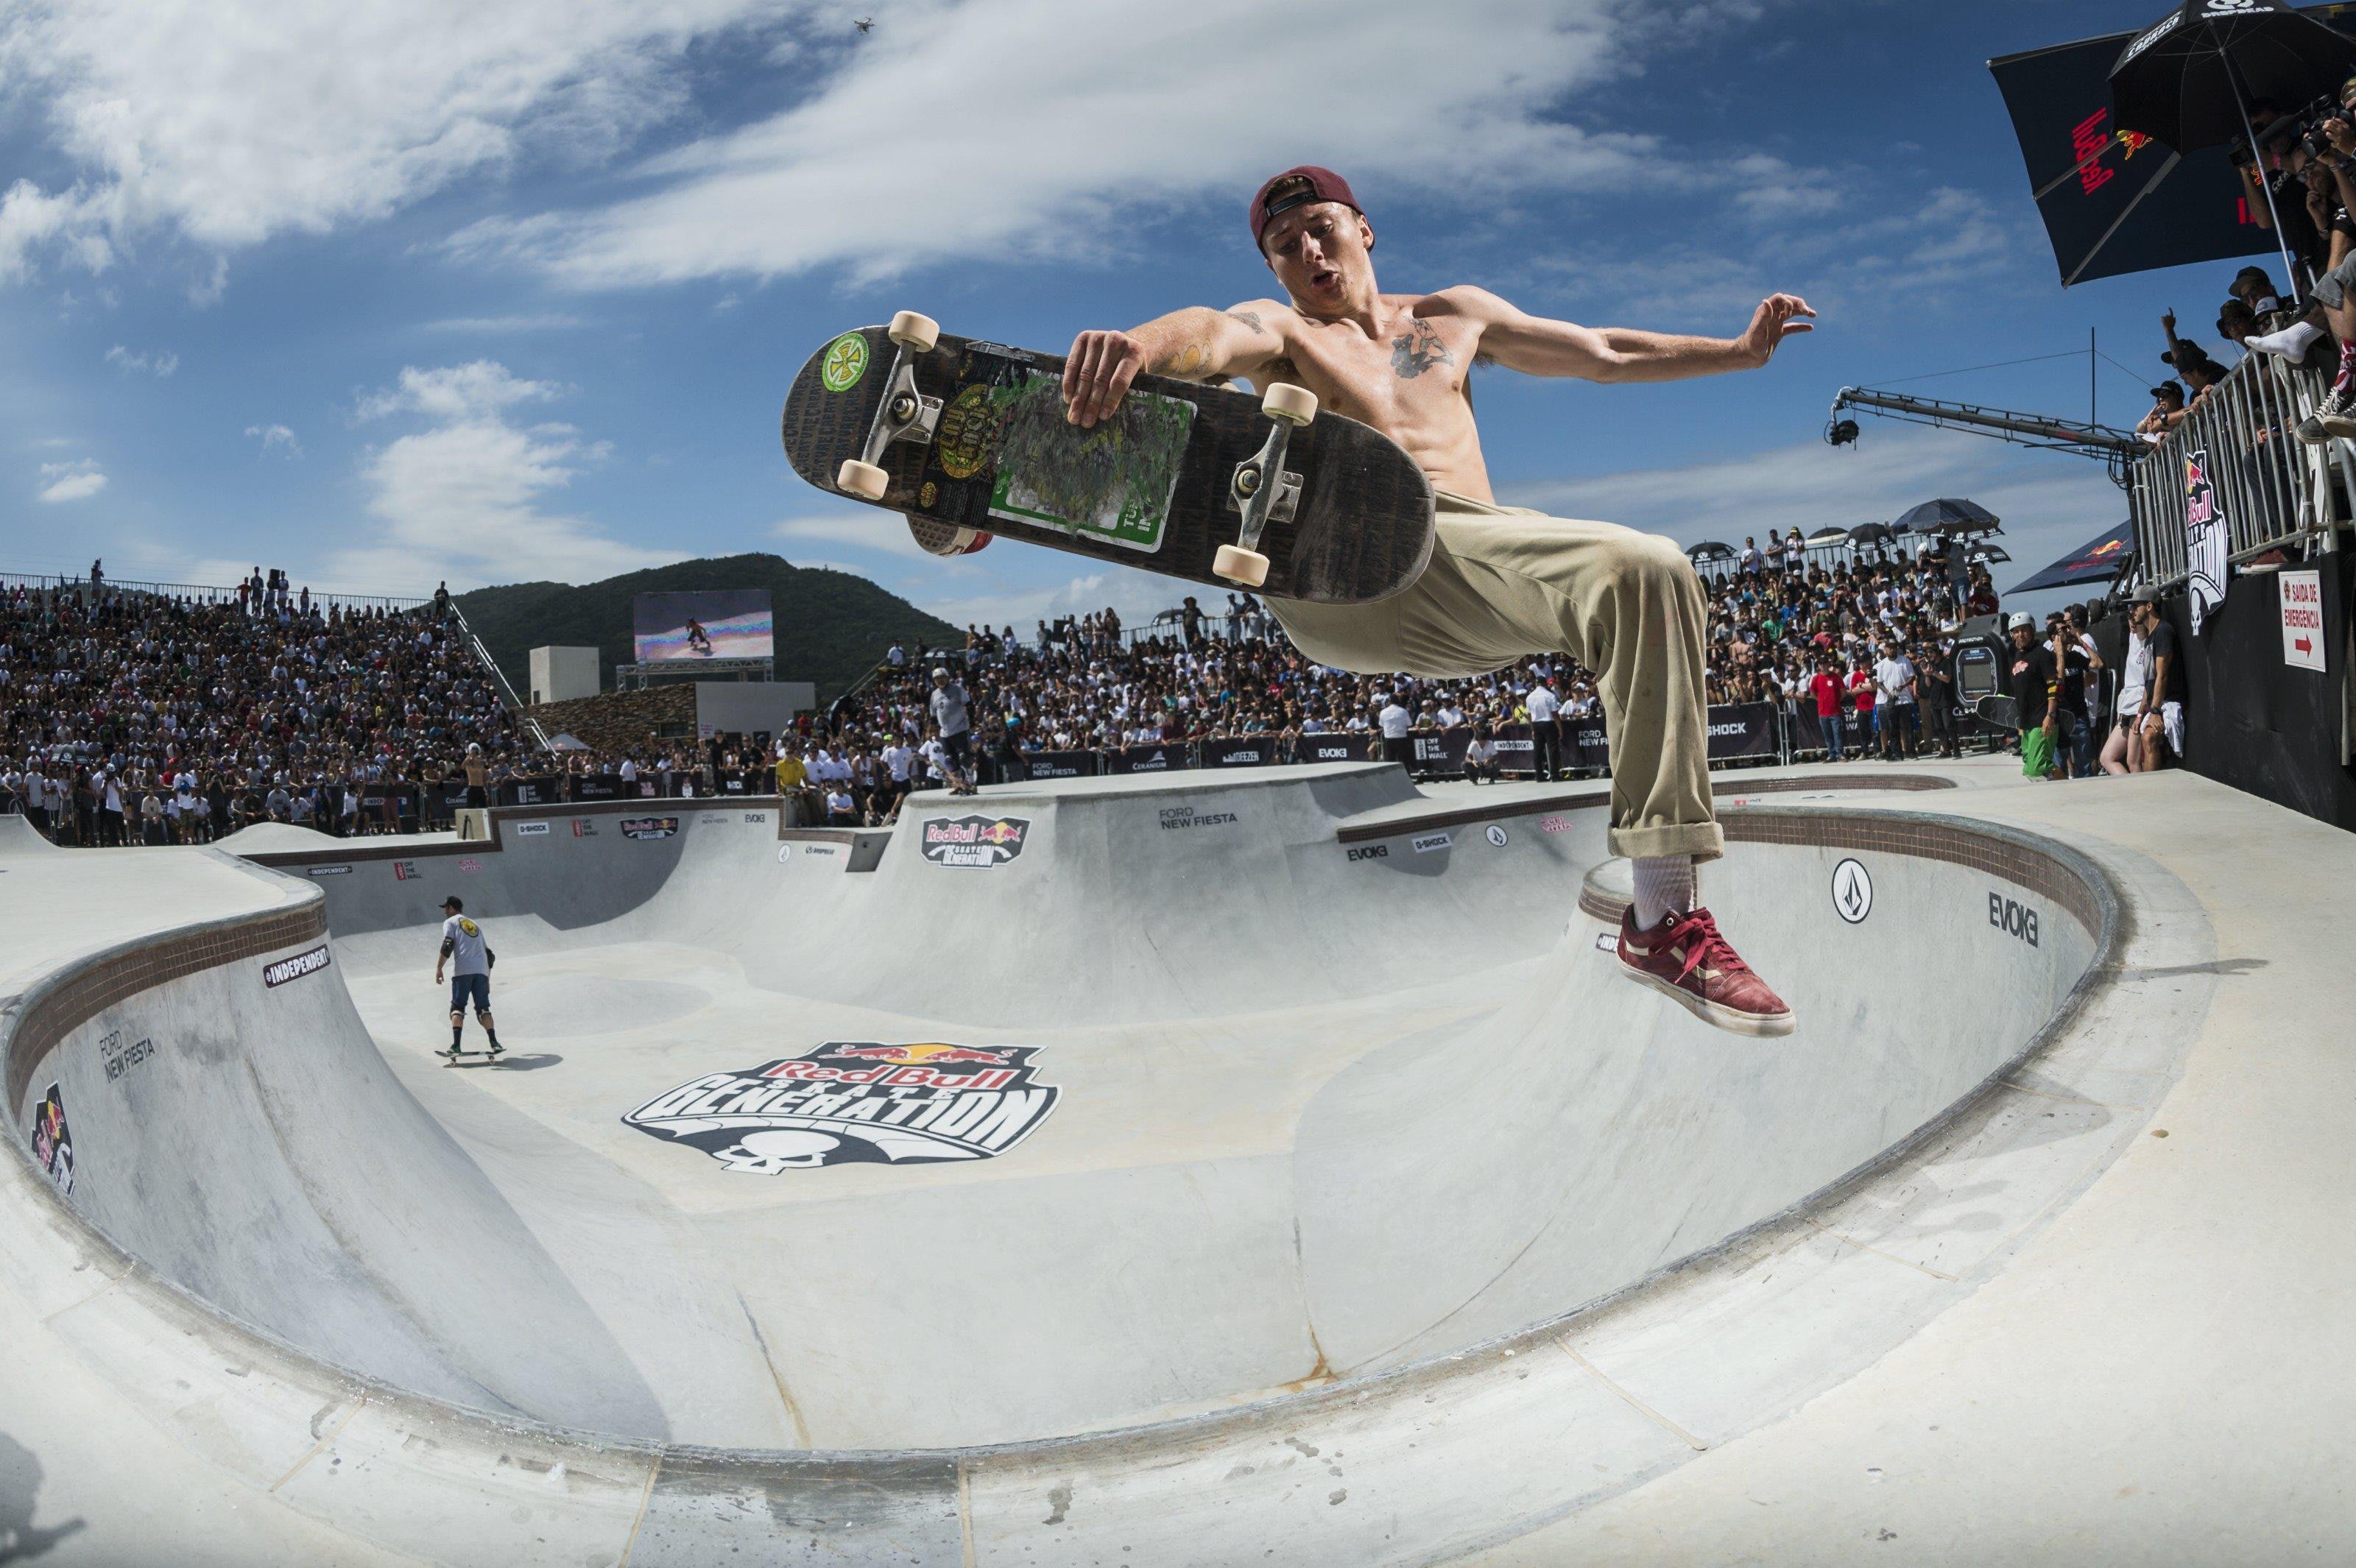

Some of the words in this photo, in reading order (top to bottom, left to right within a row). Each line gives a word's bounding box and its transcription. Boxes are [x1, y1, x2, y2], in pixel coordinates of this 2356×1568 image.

[2188, 523, 2206, 545] ATE
[2188, 517, 2225, 598] RATION
[2292, 579, 2309, 603] SAÍDA
[2309, 584, 2318, 603] DE
[1844, 714, 1856, 722] TH
[1578, 730, 1601, 738] FORD
[1707, 722, 1747, 736] SHOCK
[1579, 738, 1599, 746] NEW
[1236, 751, 1259, 763] DEEZER
[1159, 807, 1194, 819] FORD
[1161, 819, 1192, 830] NEW
[1193, 813, 1238, 827] FIESTA
[926, 823, 953, 842] Red
[952, 823, 978, 843] Bull
[1415, 836, 1449, 850] G-SHOCK
[311, 866, 349, 875] INDEPENDENT
[269, 947, 328, 983] INDEPENDENT
[99, 1030, 122, 1060] FORD
[105, 1053, 125, 1084] NEW
[123, 1036, 156, 1070] FIESTA
[761, 1061, 889, 1086] Red
[887, 1064, 1019, 1090] Bull
[771, 1079, 963, 1101] SKATE
[635, 1073, 1050, 1151] GENERATION
